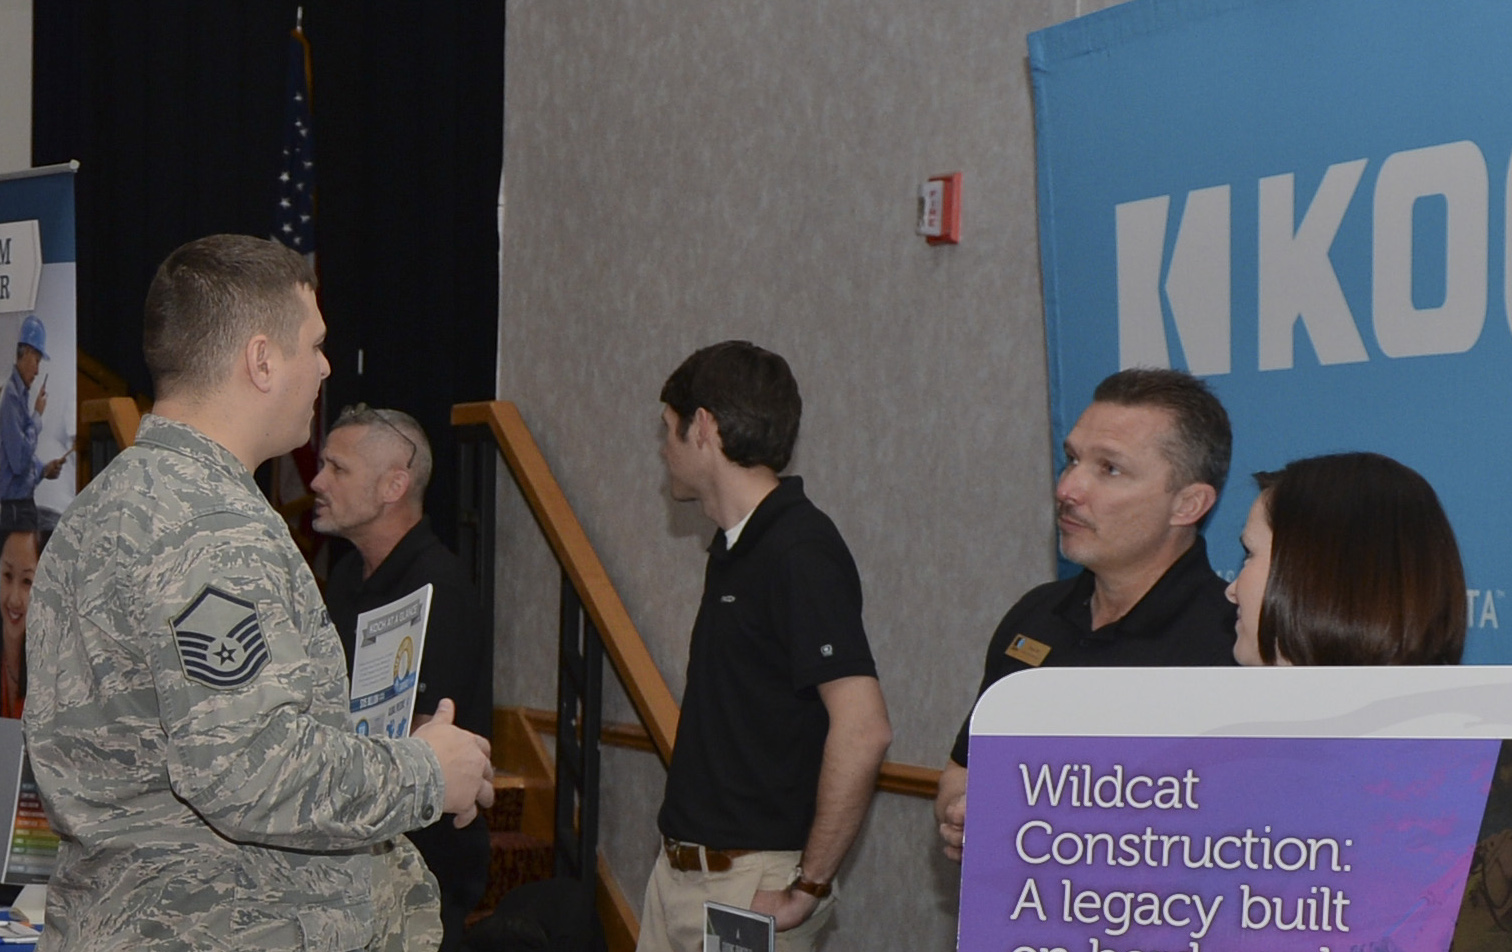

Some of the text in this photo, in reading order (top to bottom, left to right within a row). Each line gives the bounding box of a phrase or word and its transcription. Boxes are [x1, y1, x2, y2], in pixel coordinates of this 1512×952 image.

[1258, 139, 1512, 372] KO
[1019, 763, 1200, 810] Wildcat
[1015, 820, 1353, 872] Construction:
[1009, 878, 1351, 938] A legacy built
